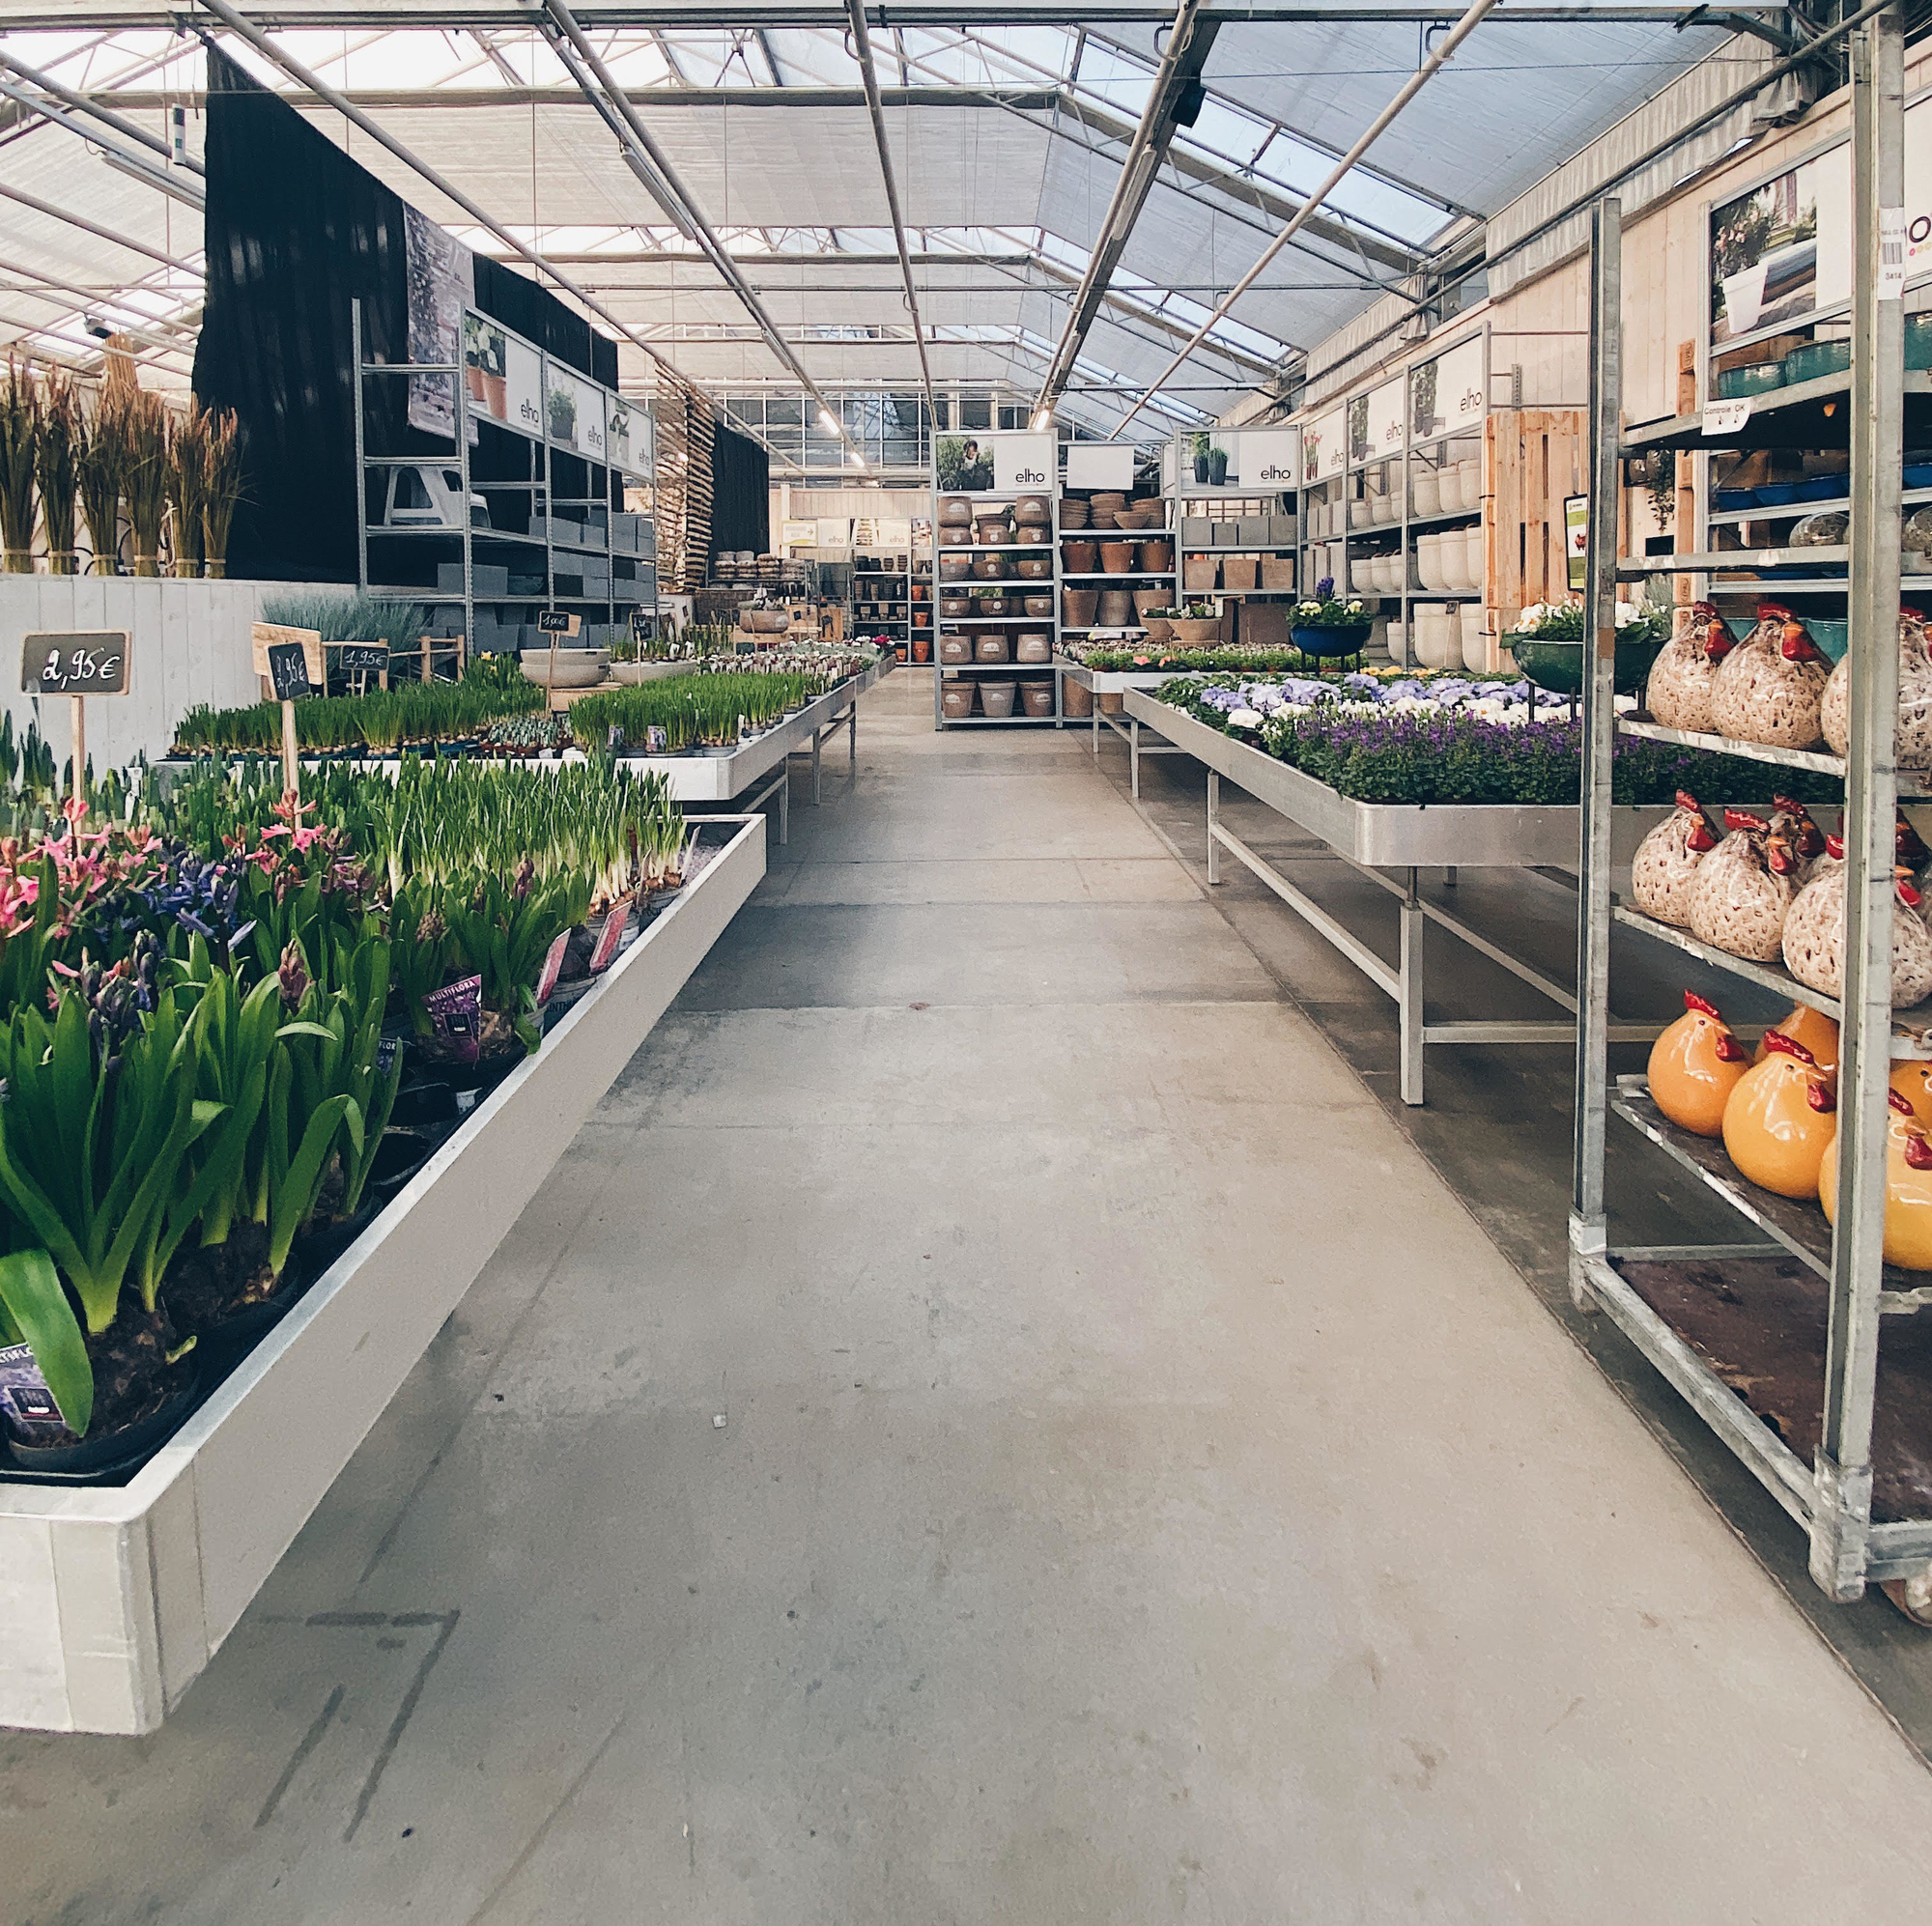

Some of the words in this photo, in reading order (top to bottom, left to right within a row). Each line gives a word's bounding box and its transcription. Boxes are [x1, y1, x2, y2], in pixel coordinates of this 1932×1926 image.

[1460, 387, 1483, 411] elho
[1734, 404, 1746, 412] OK
[520, 398, 539, 423] elho
[587, 425, 603, 446] elho
[1385, 420, 1403, 440] elho
[1015, 468, 1045, 483] elho
[1261, 465, 1292, 480] elho
[43, 646, 120, 690] 2,95€
[345, 650, 387, 668] 1,95€
[429, 979, 475, 1003] MULTIFLORA
[378, 1039, 396, 1051] FLOR
